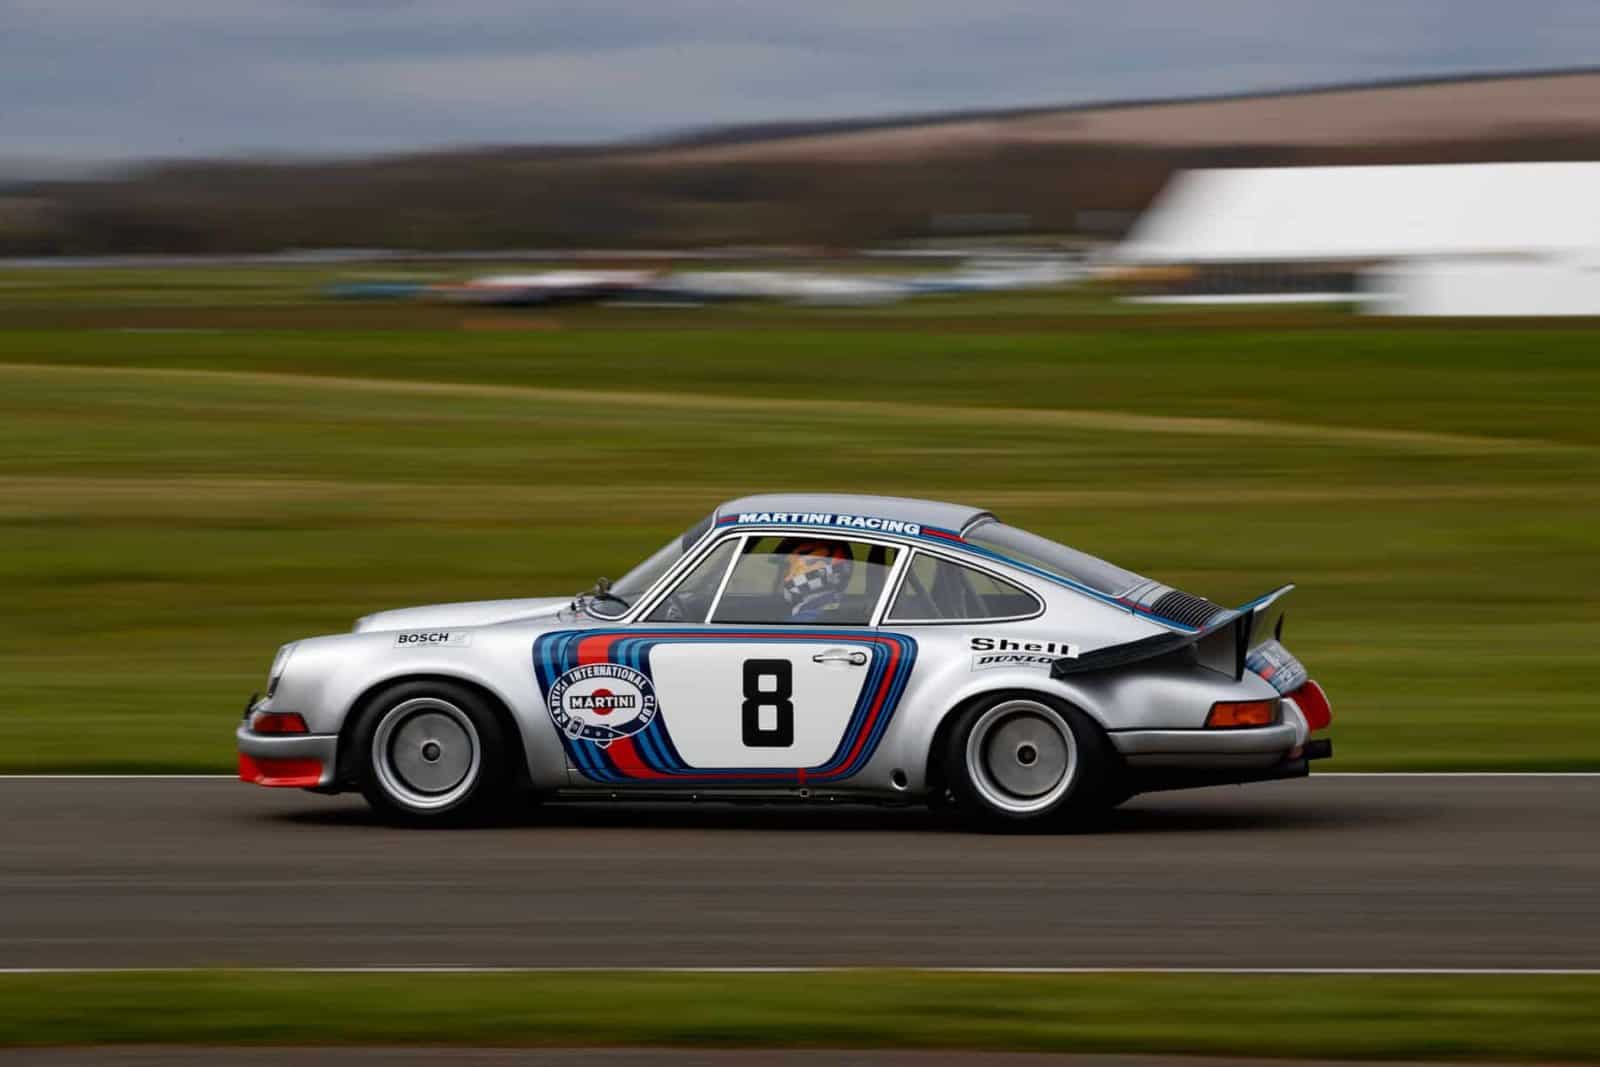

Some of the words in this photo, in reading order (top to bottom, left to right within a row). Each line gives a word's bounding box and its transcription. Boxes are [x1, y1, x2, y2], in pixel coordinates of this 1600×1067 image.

[737, 512, 832, 524] MARTINI
[835, 515, 922, 535] RACING
[398, 632, 450, 644] BOSCH
[970, 637, 1070, 656] Shell
[978, 655, 1054, 665] DUNLO
[569, 666, 647, 690] INTERNATIONAL
[638, 695, 655, 723] CLUB
[570, 695, 635, 709] MARTINI
[741, 658, 794, 748] 8
